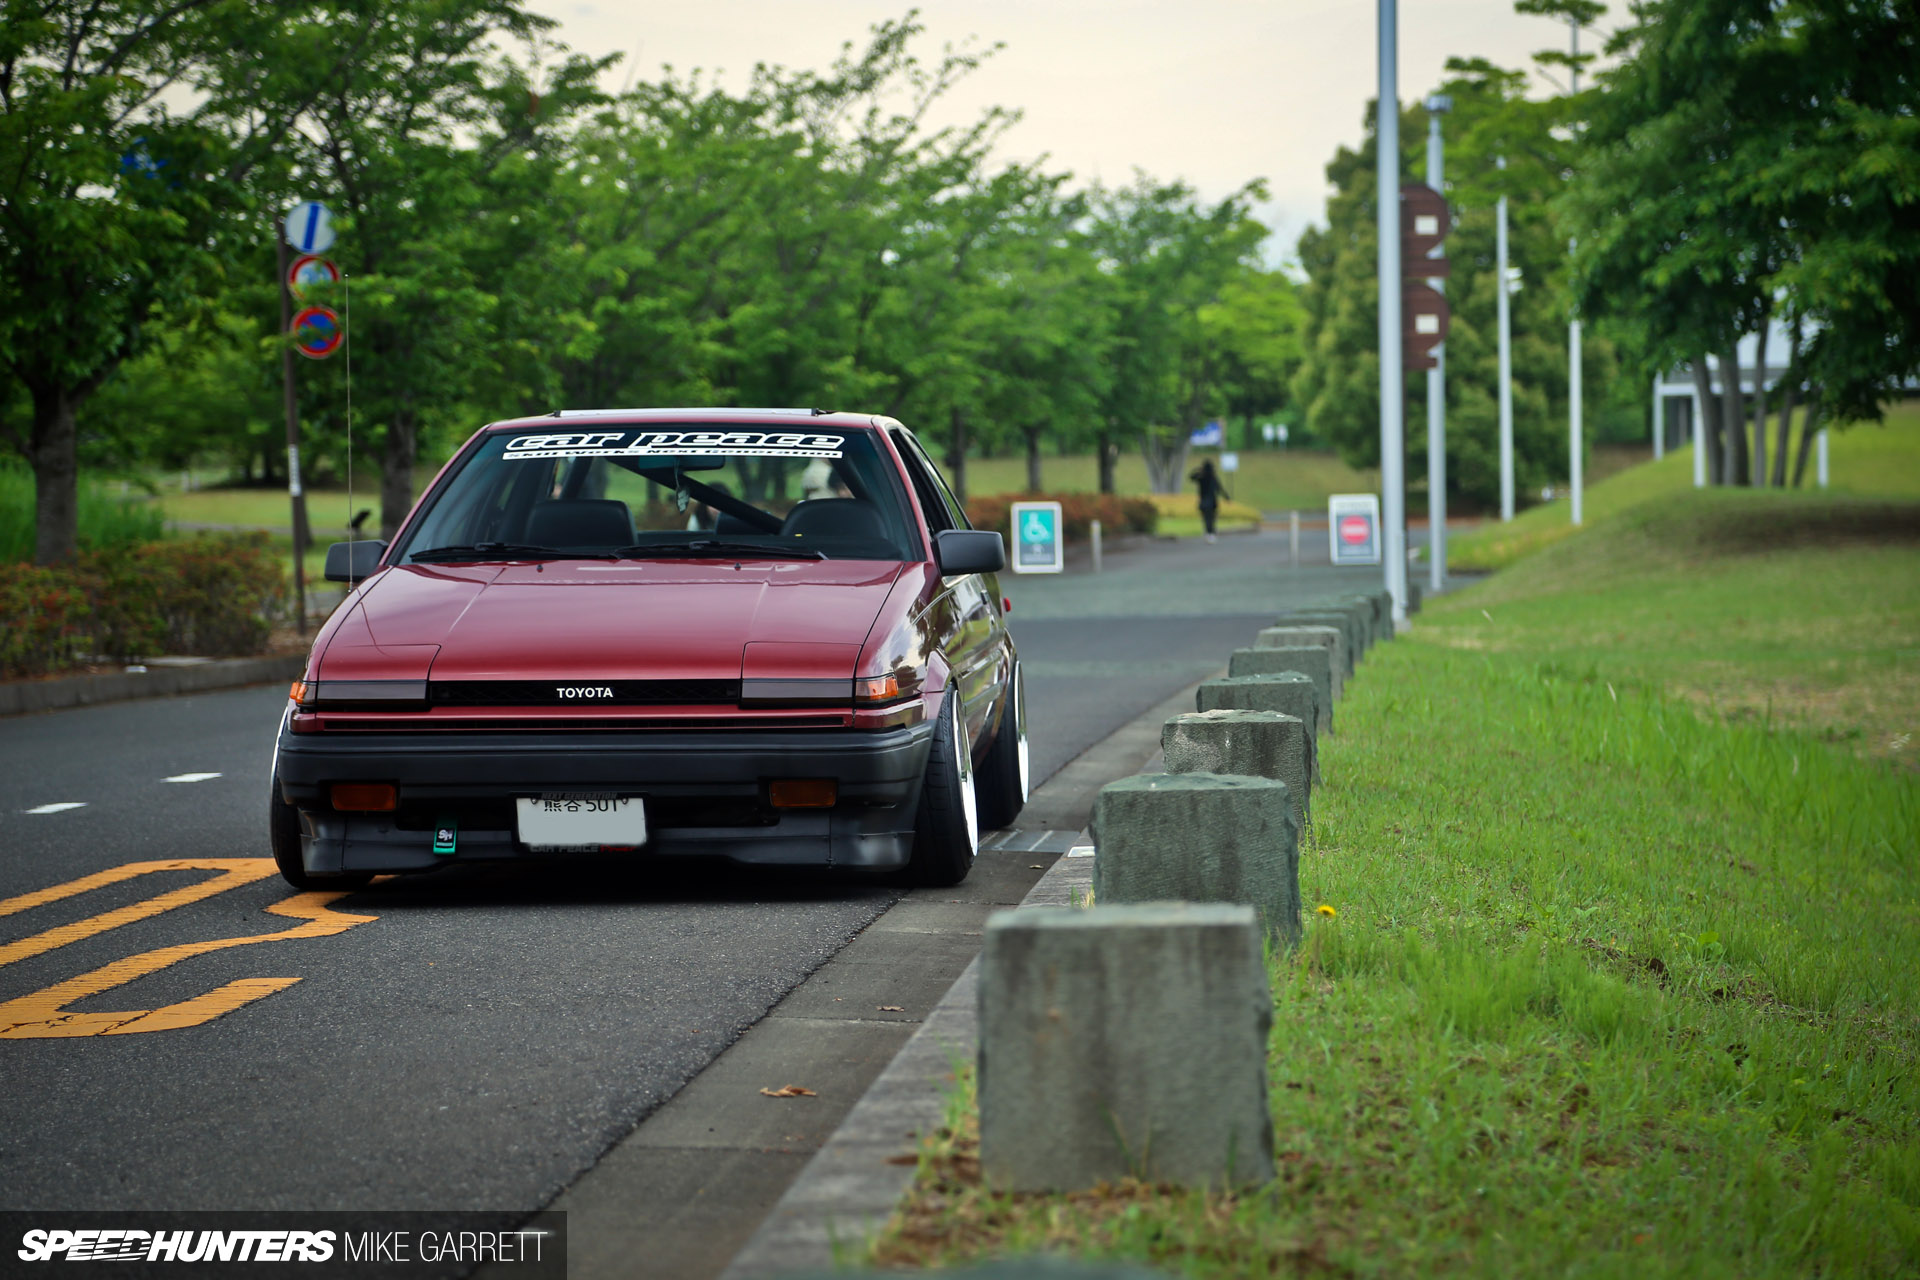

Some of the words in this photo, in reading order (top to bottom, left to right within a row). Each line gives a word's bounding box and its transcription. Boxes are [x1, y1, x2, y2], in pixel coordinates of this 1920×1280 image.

[506, 432, 625, 450] car
[628, 431, 845, 449] peace
[556, 687, 614, 698] TOYOTA
